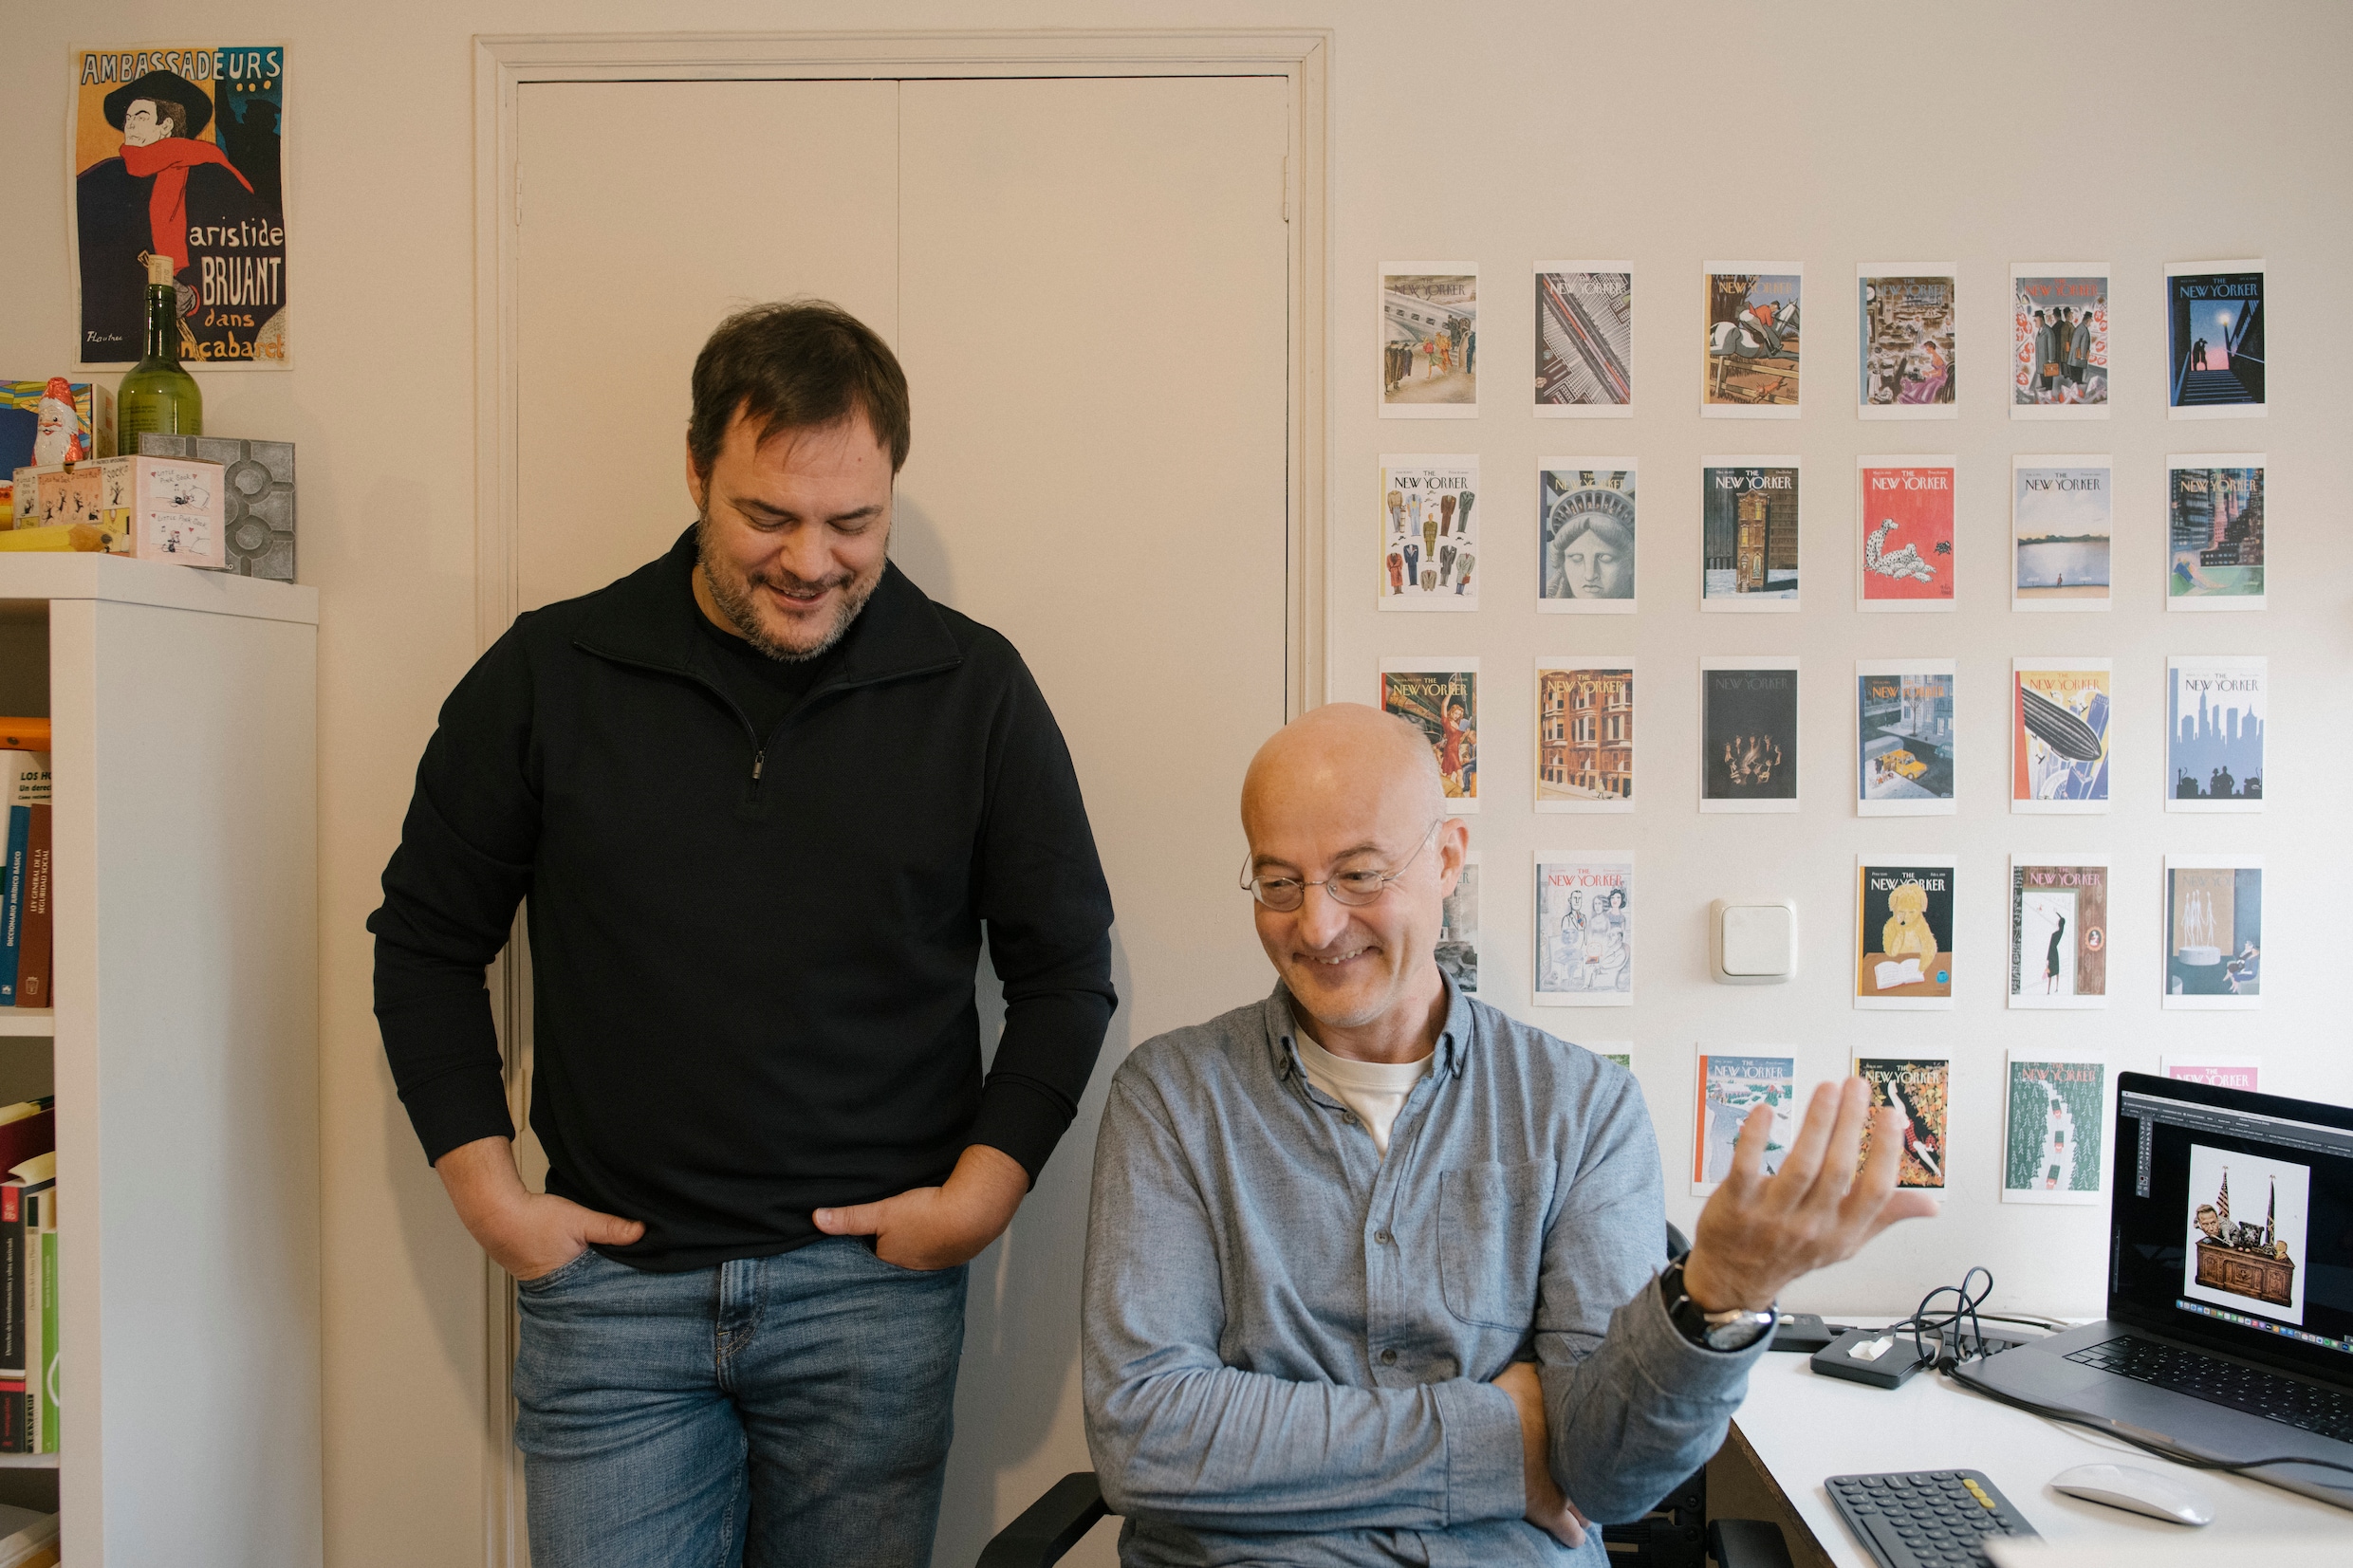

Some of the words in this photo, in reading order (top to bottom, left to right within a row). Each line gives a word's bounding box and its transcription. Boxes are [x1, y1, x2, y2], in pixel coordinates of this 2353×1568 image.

[82, 50, 282, 85] AMBASSADEURS
[189, 216, 284, 248] aristide
[201, 256, 282, 305] BRUANT
[1395, 285, 1421, 295] NEW
[1422, 285, 1465, 295] YORKER
[1719, 282, 1747, 293] NEW
[1748, 282, 1793, 294] YORKER
[1877, 285, 1900, 296] NEW
[1902, 285, 1946, 296] YORKER
[2026, 285, 2051, 296] NEW
[2055, 285, 2098, 296] YORKER
[2179, 286, 2209, 298] NEW
[2211, 284, 2258, 297] YORKER
[204, 307, 255, 327] dans
[197, 330, 285, 359] cabaret
[1395, 477, 1422, 489] NEW
[1423, 477, 1469, 489] YORKER
[1715, 476, 1745, 489] NEW
[1746, 476, 1792, 489] YORKER
[1872, 477, 1899, 489] NEW
[1901, 477, 1949, 489] YORKER
[2026, 479, 2053, 490] NEW
[2055, 479, 2101, 491] YORKER
[2180, 480, 2209, 492] NEW
[2210, 480, 2257, 492] YORKER
[1394, 684, 1421, 696] NEW
[1422, 684, 1468, 696] YORKER
[1547, 680, 1576, 693] NEW
[1577, 680, 1622, 693] YORKER
[1716, 677, 1743, 690] NEW
[1744, 677, 1788, 690] YORKER
[2029, 679, 2055, 690] NEW
[2058, 679, 2100, 691] YORKER
[2185, 679, 2213, 691] NEW
[2214, 679, 2259, 692] YORKER
[1872, 686, 1899, 698] NEW
[20, 771, 38, 781] LOS
[34, 849, 42, 858] LA
[13, 851, 22, 875] BÁSICO
[33, 859, 41, 868] DE
[41, 850, 49, 874] SOCIAL
[31, 870, 40, 899] GENERAL
[1547, 875, 1576, 886] NEW
[1578, 875, 1623, 887] YORKER
[1870, 878, 1899, 891] NEW
[2030, 873, 2057, 885] NEW
[2058, 873, 2101, 886] YORKER
[10, 876, 19, 904] JURÍDICO
[38, 876, 47, 914] SEGURIDAD
[7, 905, 17, 947] DICCIONARIO
[1714, 1064, 1740, 1077] NEW
[1742, 1066, 1783, 1079] YORKER
[1865, 1071, 1894, 1083] NEW
[1894, 1071, 1940, 1084] YORKER
[2022, 1068, 2049, 1080] NEW
[2051, 1069, 2096, 1082] YORKER
[2204, 1074, 2249, 1086] YORKER
